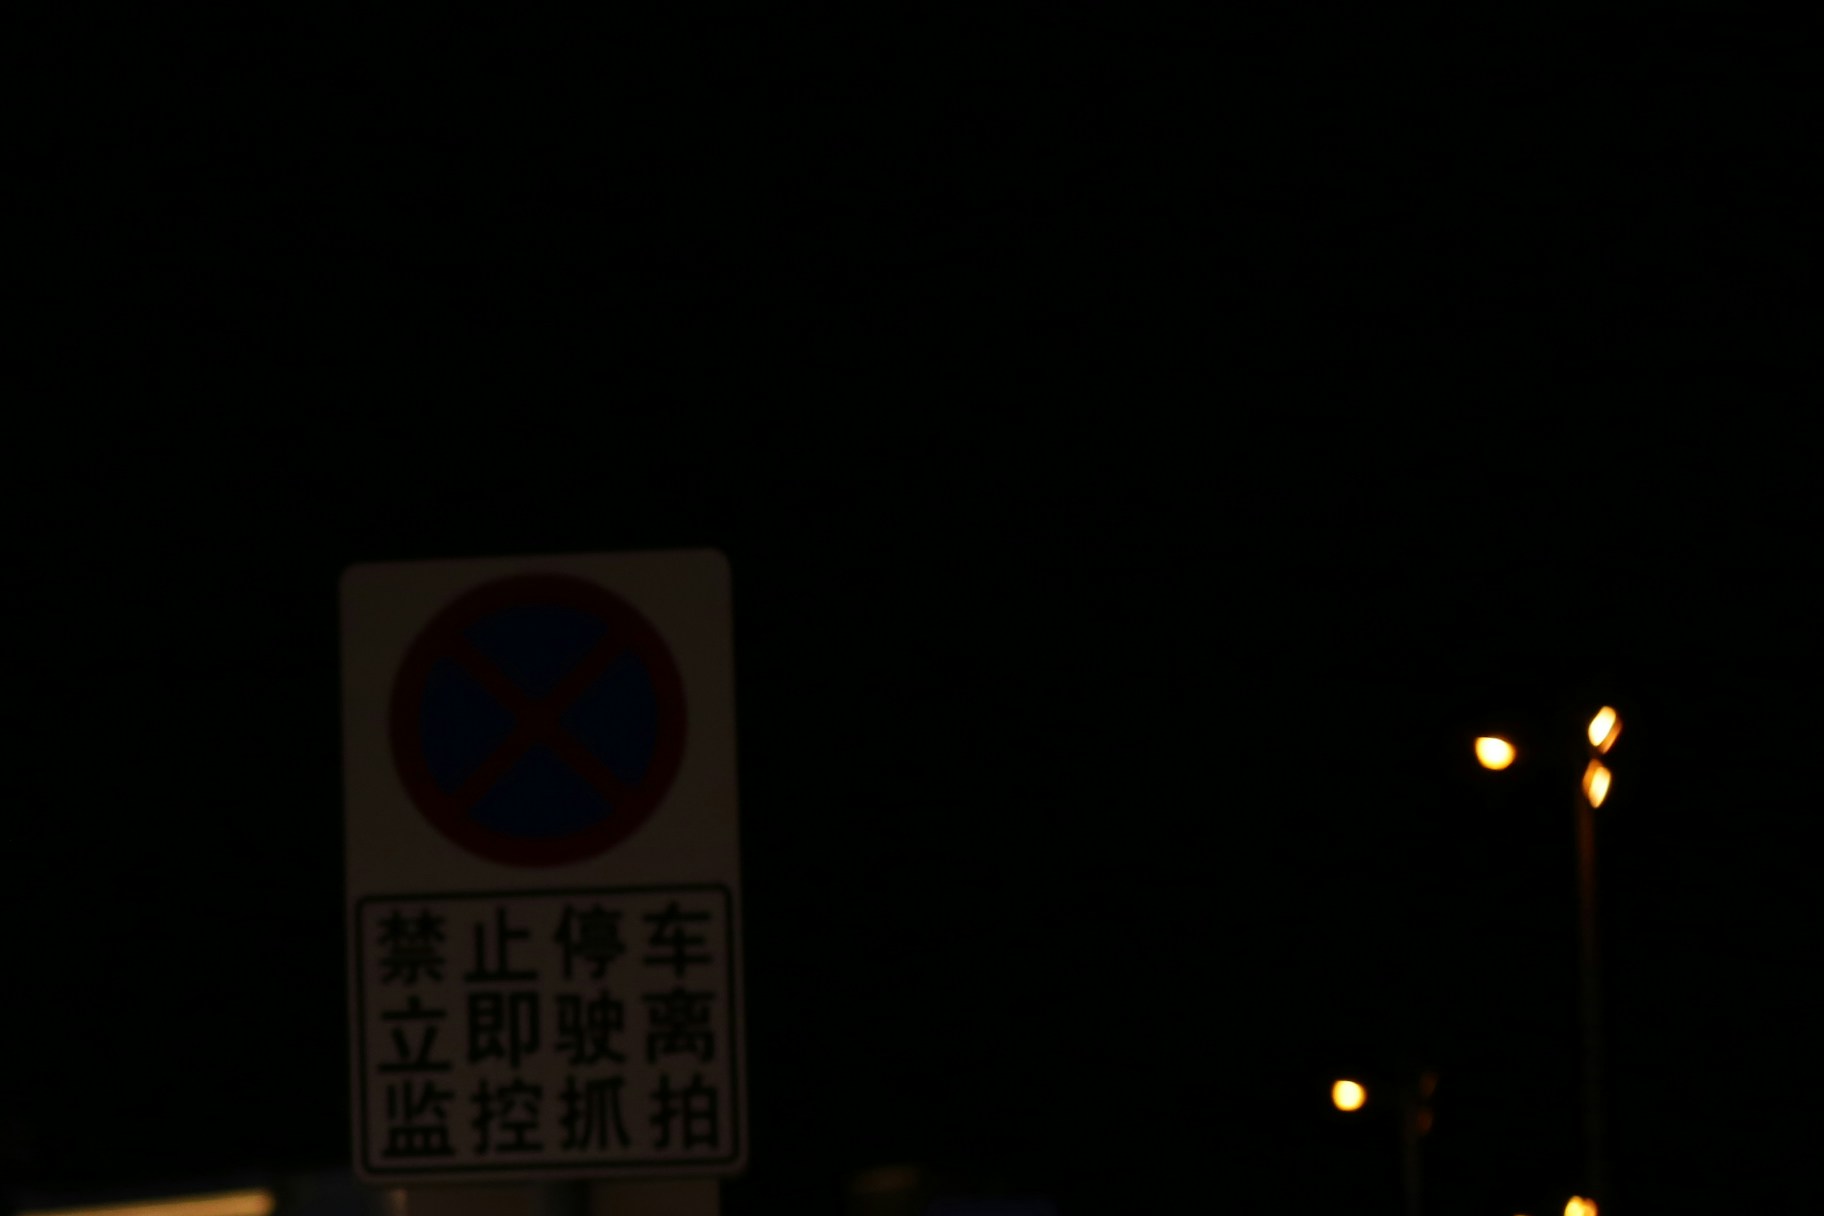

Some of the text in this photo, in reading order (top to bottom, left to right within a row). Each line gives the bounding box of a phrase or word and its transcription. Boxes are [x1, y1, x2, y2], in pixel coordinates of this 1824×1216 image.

[380, 903, 712, 983] 禁止停车
[379, 988, 716, 1073] 立即驶离
[382, 1073, 719, 1157] 监控抓拍
